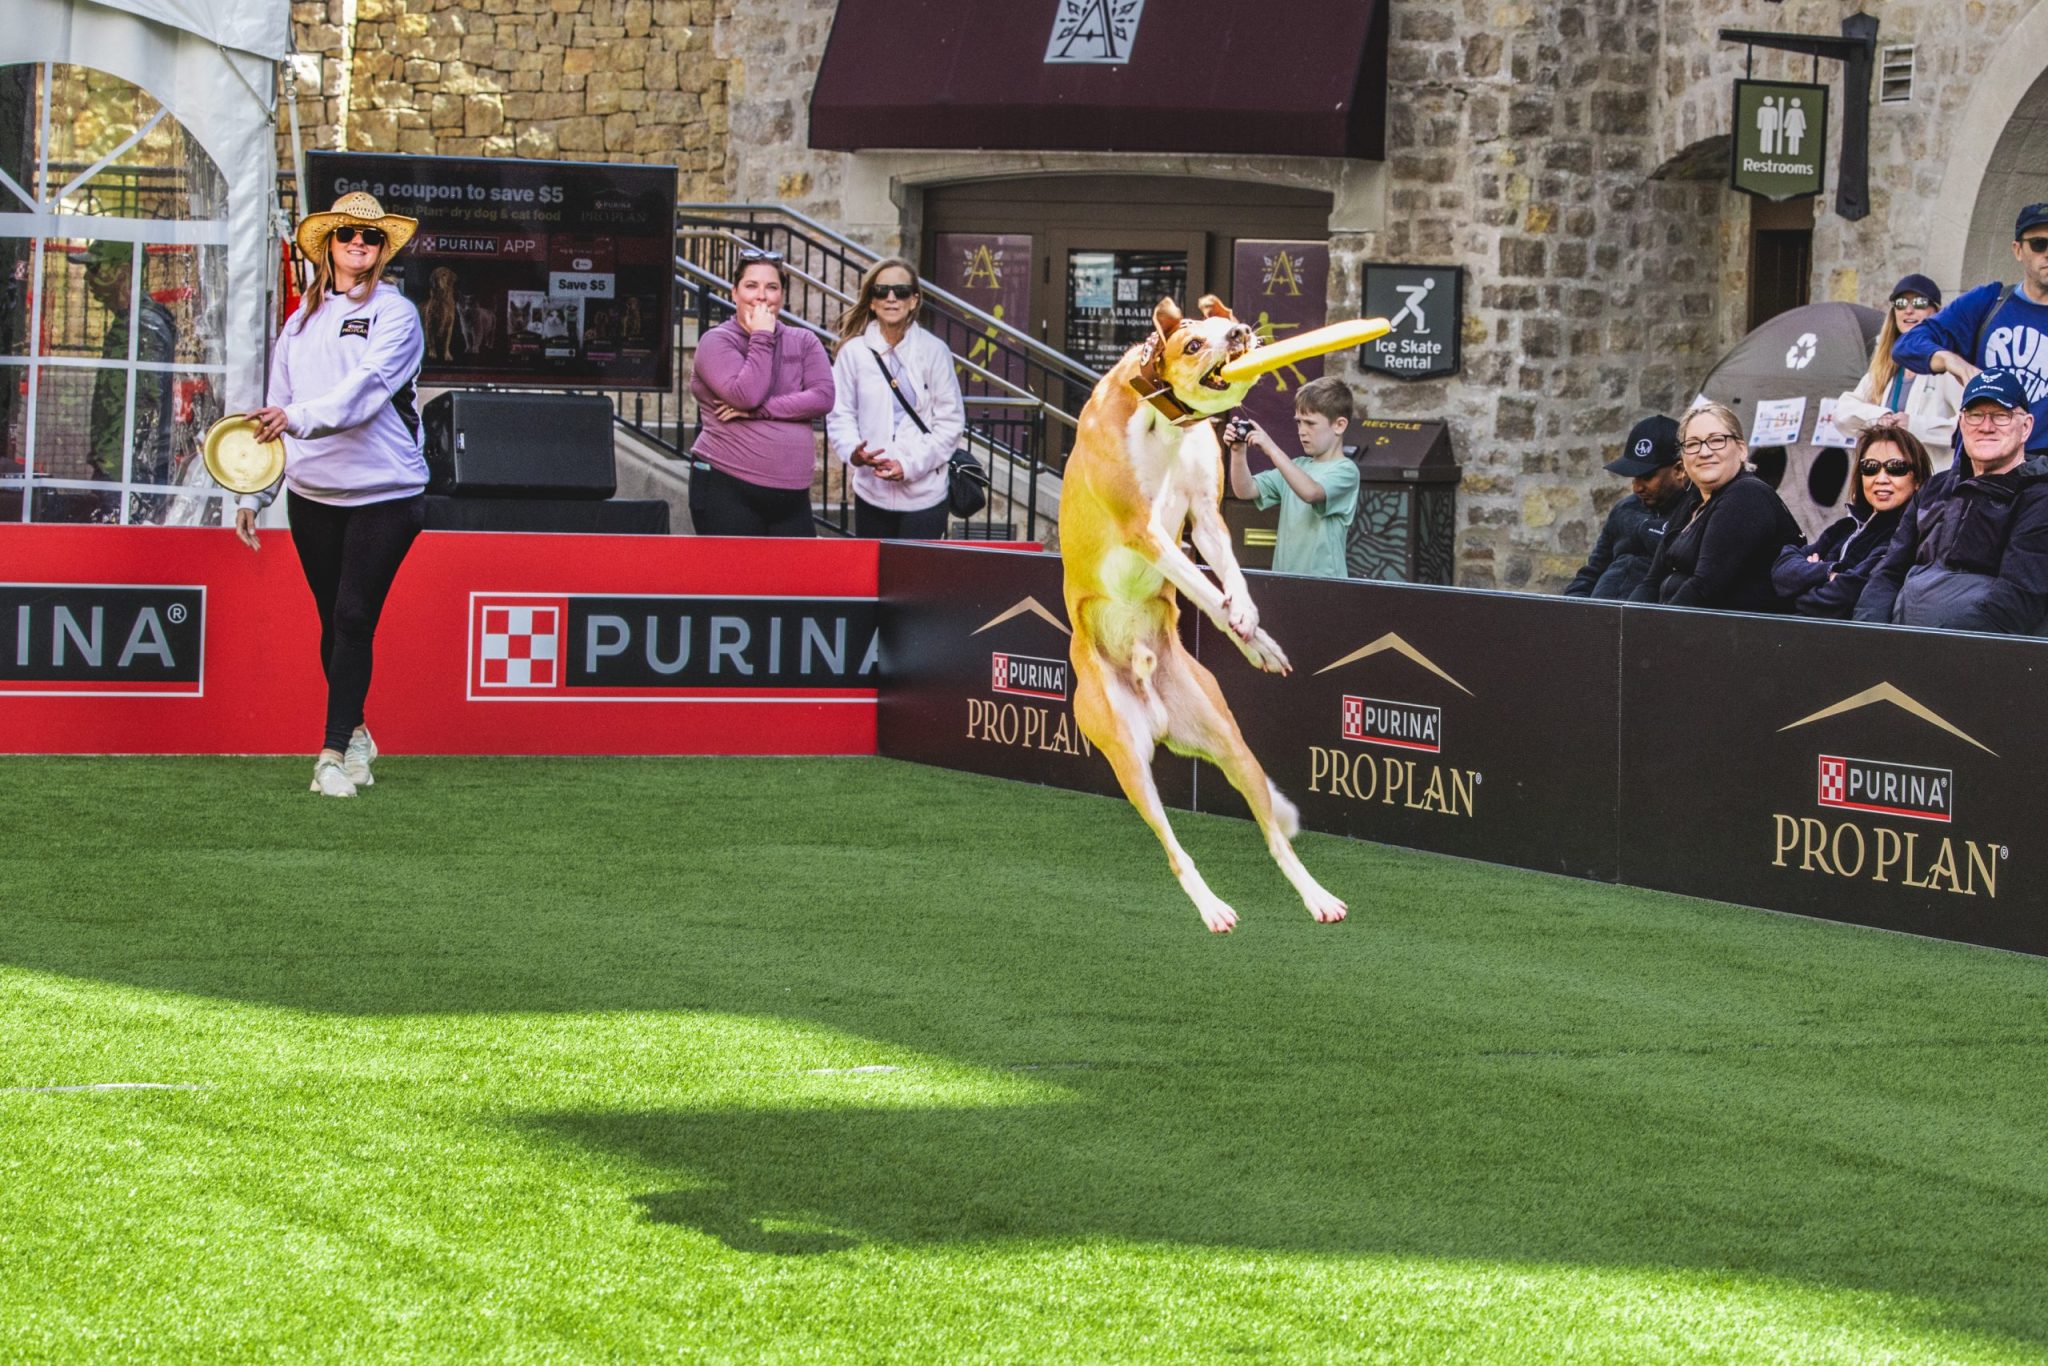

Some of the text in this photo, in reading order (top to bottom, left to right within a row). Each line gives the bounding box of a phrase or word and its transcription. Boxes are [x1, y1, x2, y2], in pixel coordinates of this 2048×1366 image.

[1743, 158, 1814, 175] Restrooms
[334, 178, 564, 204] Get a coupon to save $5
[450, 207, 471, 221] dry
[474, 208, 498, 222] dog
[511, 211, 530, 221] cat
[533, 209, 561, 221] food
[504, 240, 535, 252] APP
[559, 279, 606, 292] Save $5
[1375, 339, 1442, 354] Ice Skate
[1384, 354, 1432, 369] Rental
[1362, 420, 1422, 431] RECYCLE
[966, 698, 1019, 745] PRO
[1308, 746, 1377, 800] PRO
[1772, 813, 1866, 878] PRO
